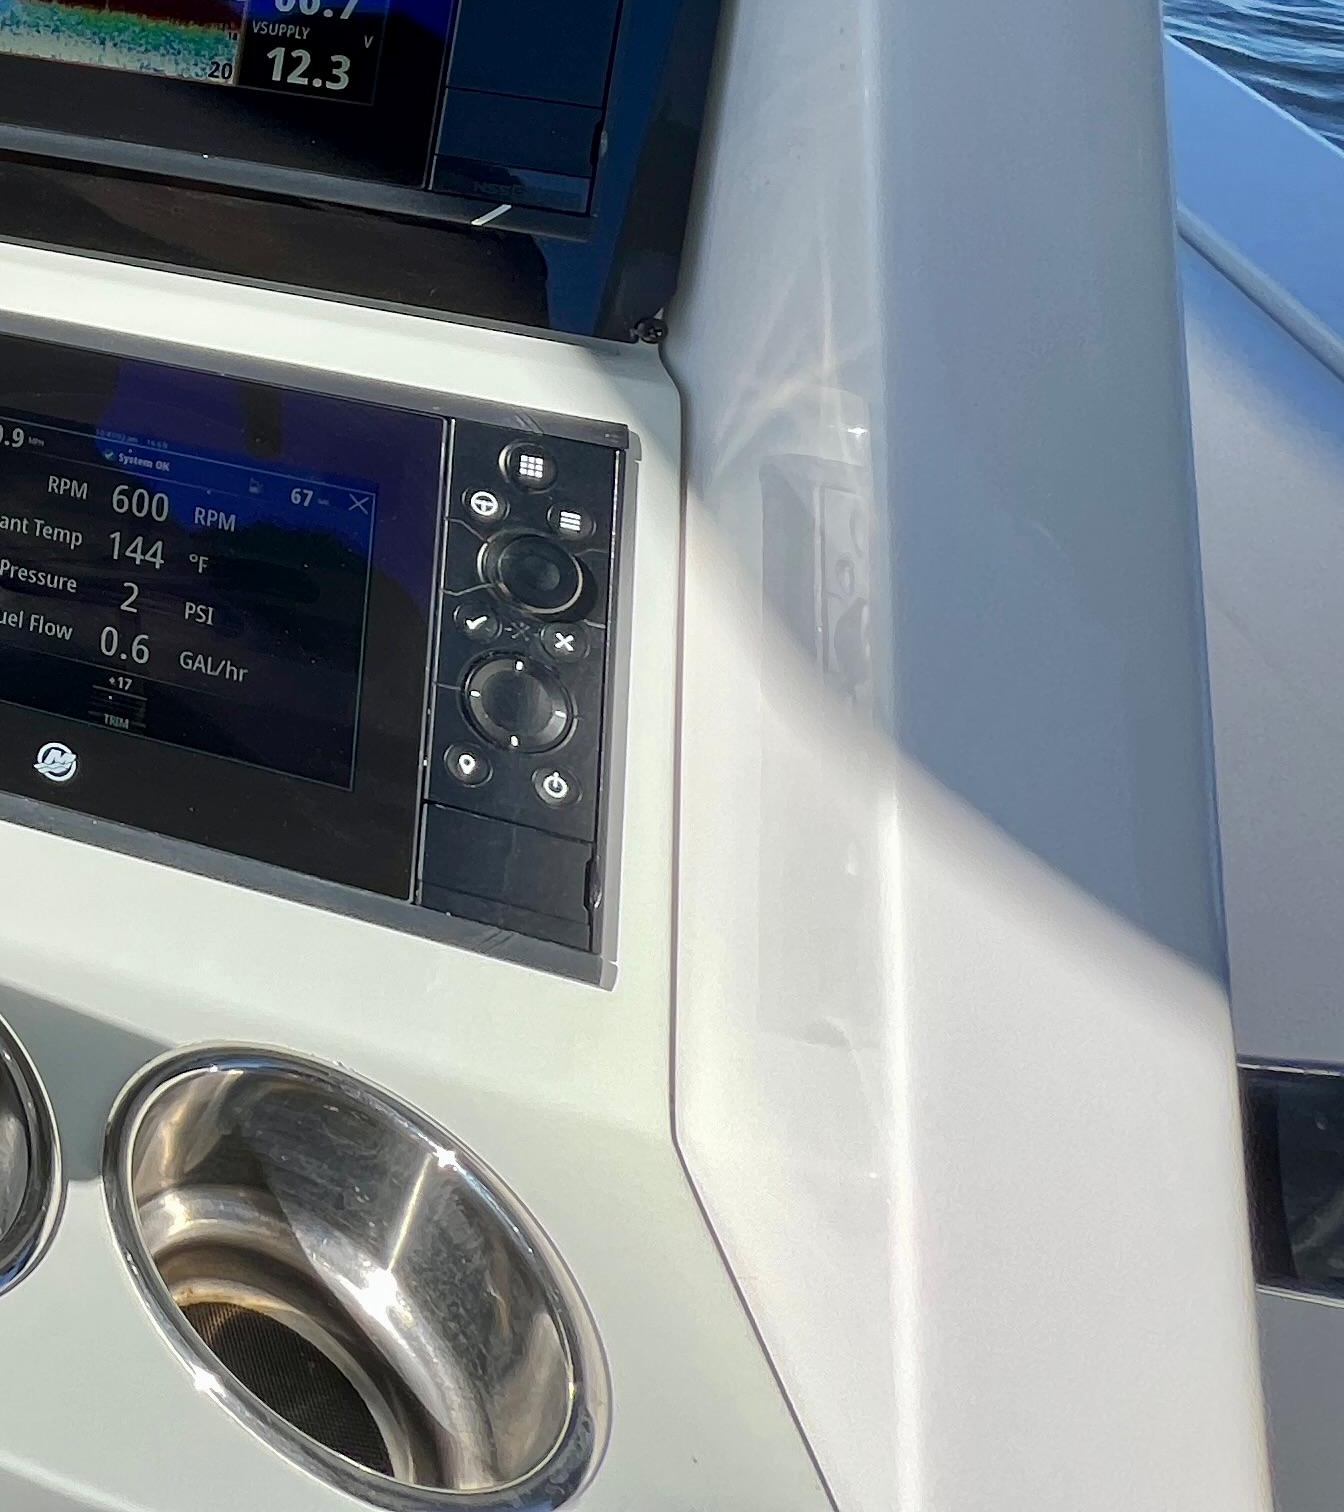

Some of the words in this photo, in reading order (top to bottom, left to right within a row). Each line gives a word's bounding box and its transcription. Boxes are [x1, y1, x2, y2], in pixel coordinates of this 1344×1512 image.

[252, 20, 310, 39] VSUPPLY
[364, 36, 374, 48] V
[208, 61, 233, 79] 20
[266, 46, 351, 90] 12.3
[118, 452, 153, 468] System
[155, 460, 170, 472] OK
[48, 475, 88, 500] RPM
[112, 485, 169, 522] 600
[194, 507, 237, 532] RPM
[291, 488, 313, 507] 67
[33, 519, 83, 550] Temp
[110, 532, 164, 569] 144
[189, 553, 209, 573] °F
[0, 559, 77, 593] Pressure
[120, 582, 139, 613] 2
[184, 601, 214, 626] PSI
[29, 614, 73, 640] Flow
[100, 626, 150, 664] 0.6
[179, 651, 248, 682] GAL/hr
[103, 714, 129, 729] TRIM
